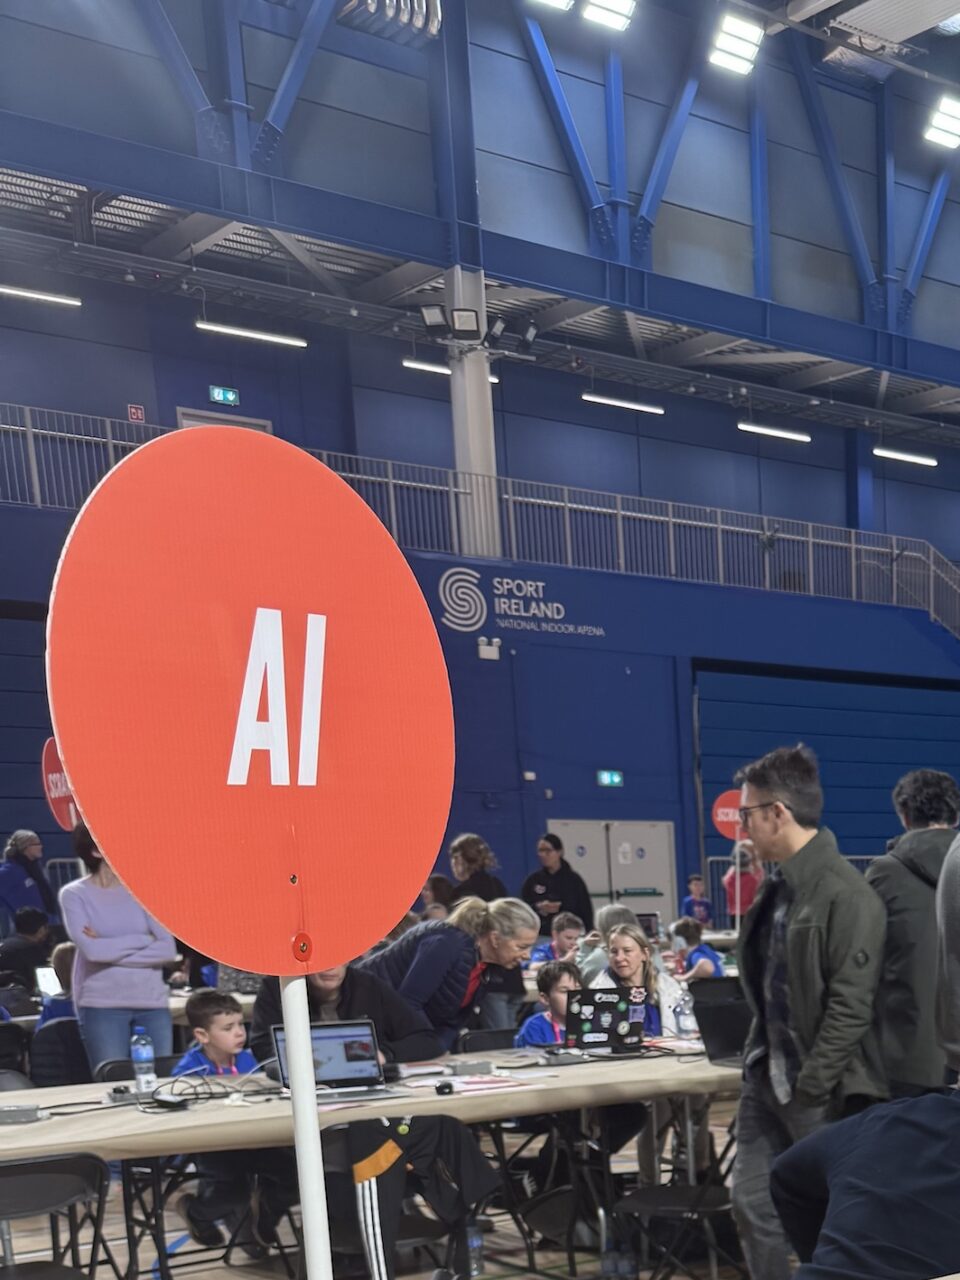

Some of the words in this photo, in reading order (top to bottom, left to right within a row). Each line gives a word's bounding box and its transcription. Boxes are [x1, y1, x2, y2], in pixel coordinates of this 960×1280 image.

[493, 577, 546, 598] SPORT
[495, 598, 565, 620] IRELAND
[496, 619, 541, 632] NATIONAL
[542, 622, 576, 634] INDOOR
[226, 607, 327, 786] AI
